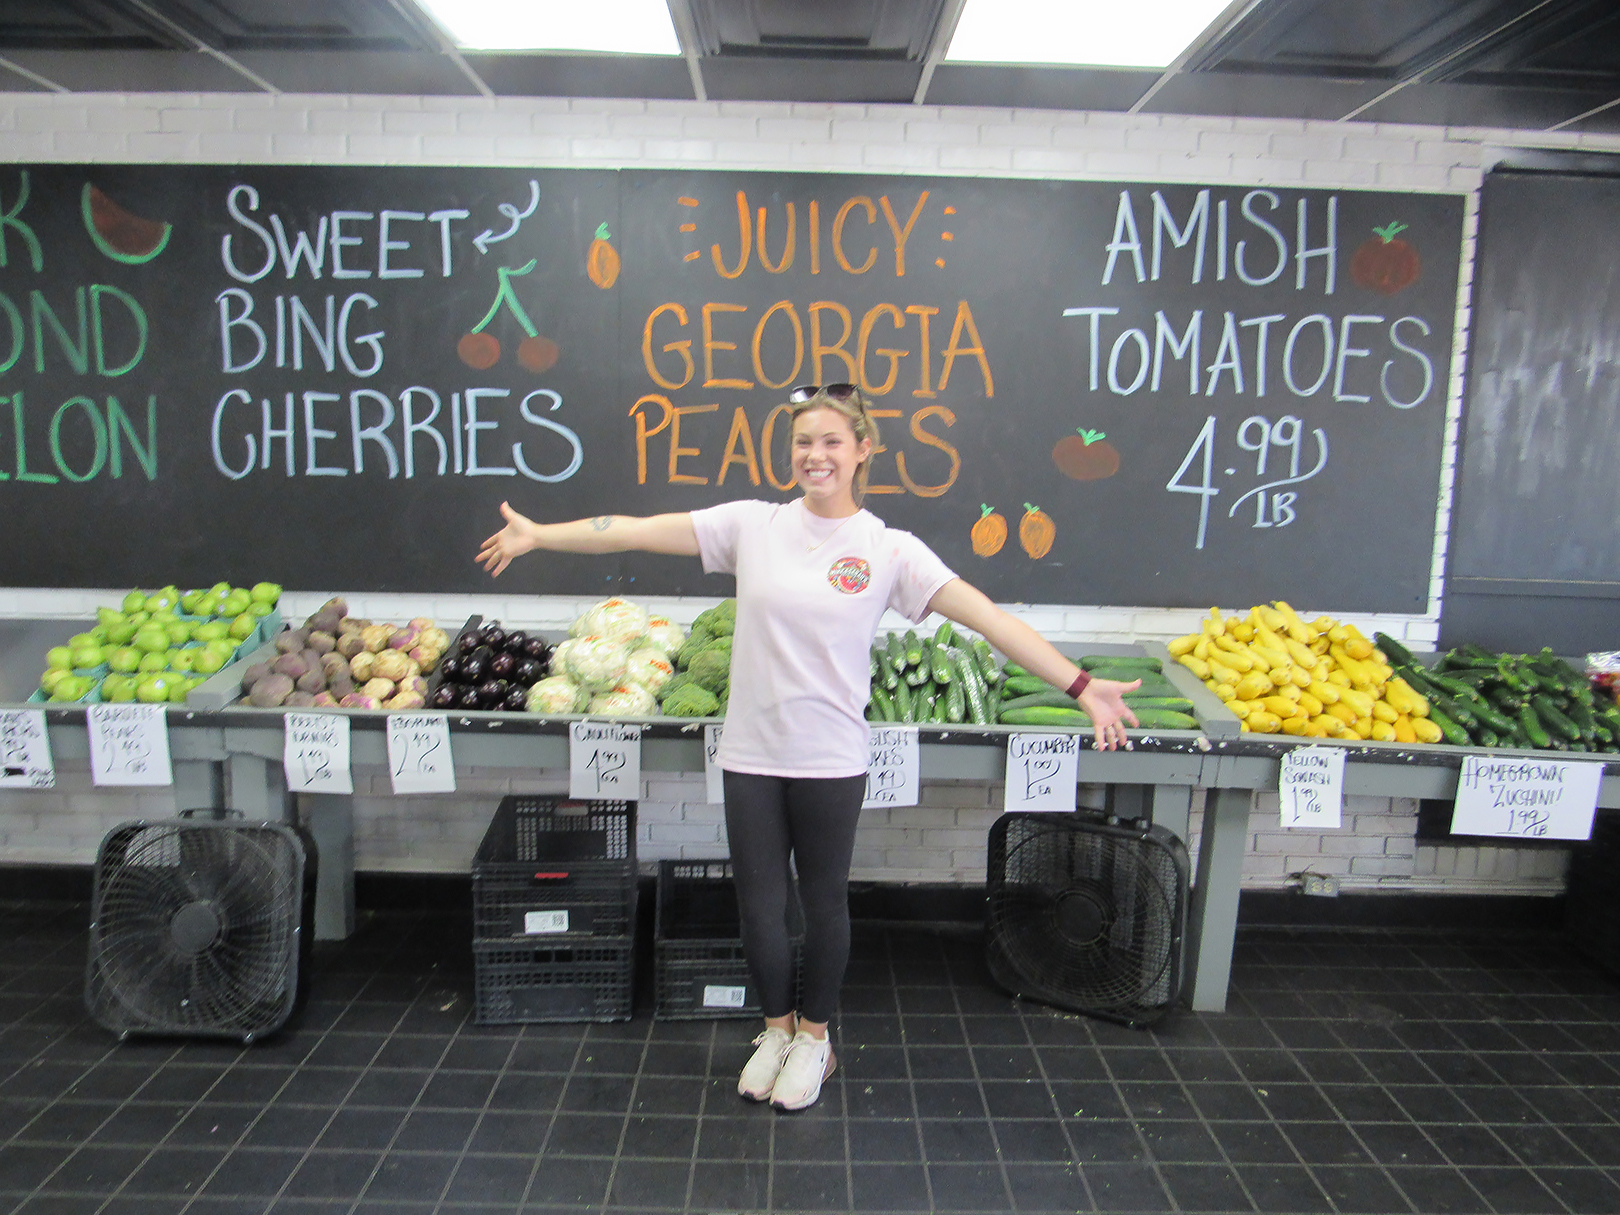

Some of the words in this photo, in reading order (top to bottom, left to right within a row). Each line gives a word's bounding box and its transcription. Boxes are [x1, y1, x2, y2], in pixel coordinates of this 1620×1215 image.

[221, 184, 470, 283] SWEET
[711, 191, 931, 279] JUICY
[1101, 190, 1338, 295] AMISH
[215, 288, 386, 377] BING
[642, 300, 995, 399] GEORGIA
[1062, 307, 1434, 410] TOMATOES
[0, 391, 158, 483] LON
[211, 386, 584, 483] CHERRIES
[1251, 491, 1298, 528] LB
